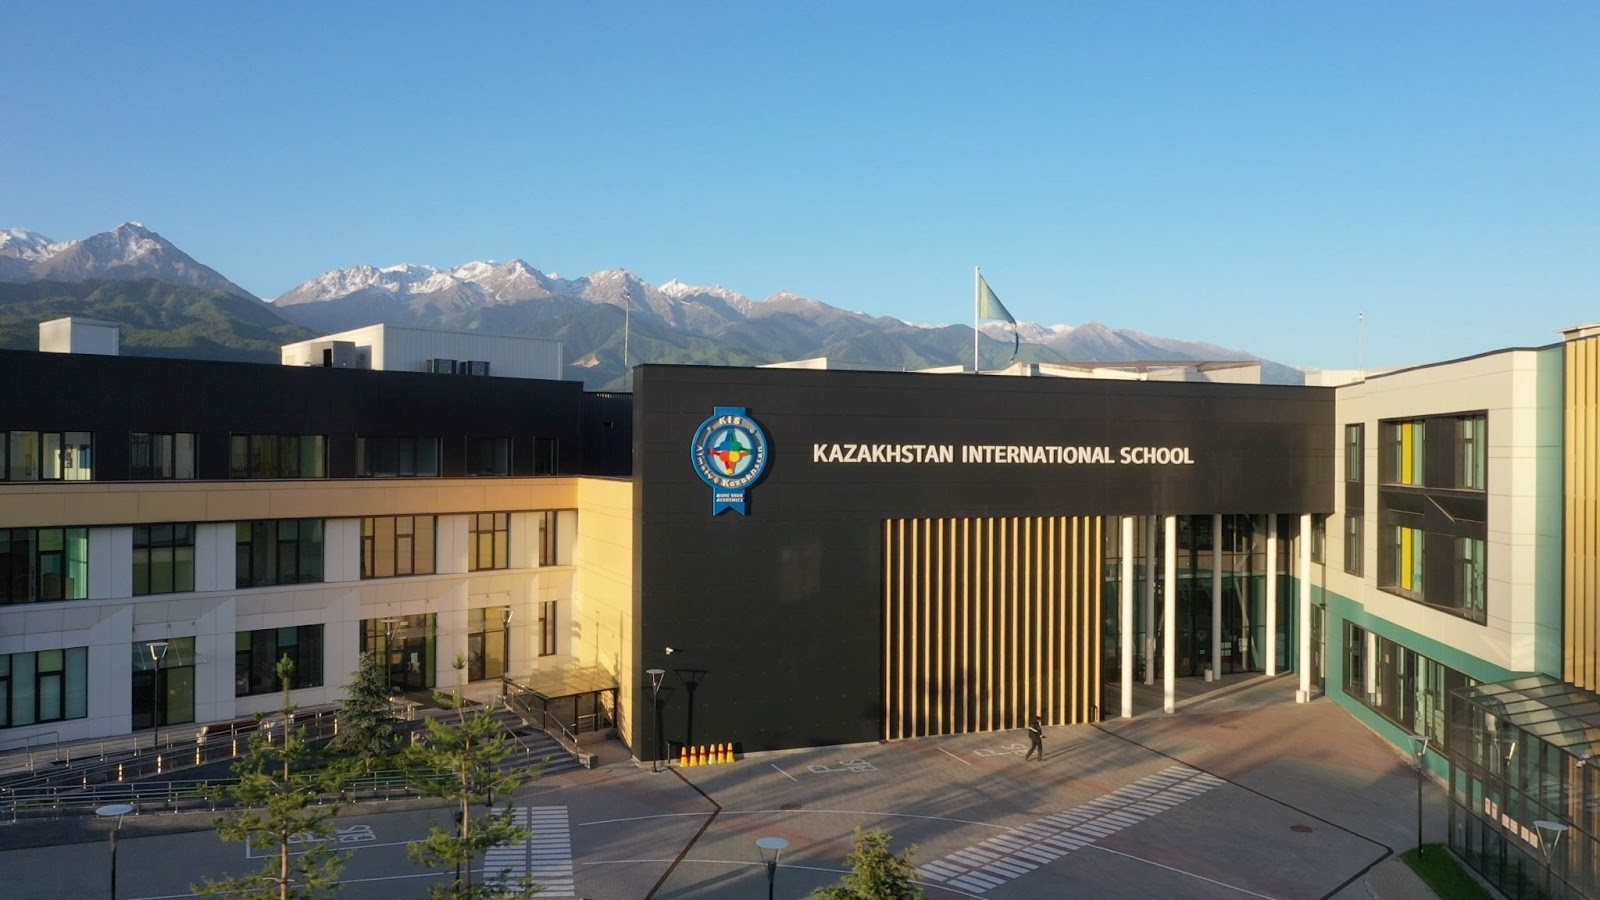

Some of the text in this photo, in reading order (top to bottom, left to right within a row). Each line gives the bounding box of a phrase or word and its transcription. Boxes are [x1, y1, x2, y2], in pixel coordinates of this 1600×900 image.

[719, 416, 741, 425] KIS
[813, 444, 1194, 465] KAZAKHSTAN INTERNATIONAL SCHOOL
[722, 446, 763, 487] Kazakhstan
